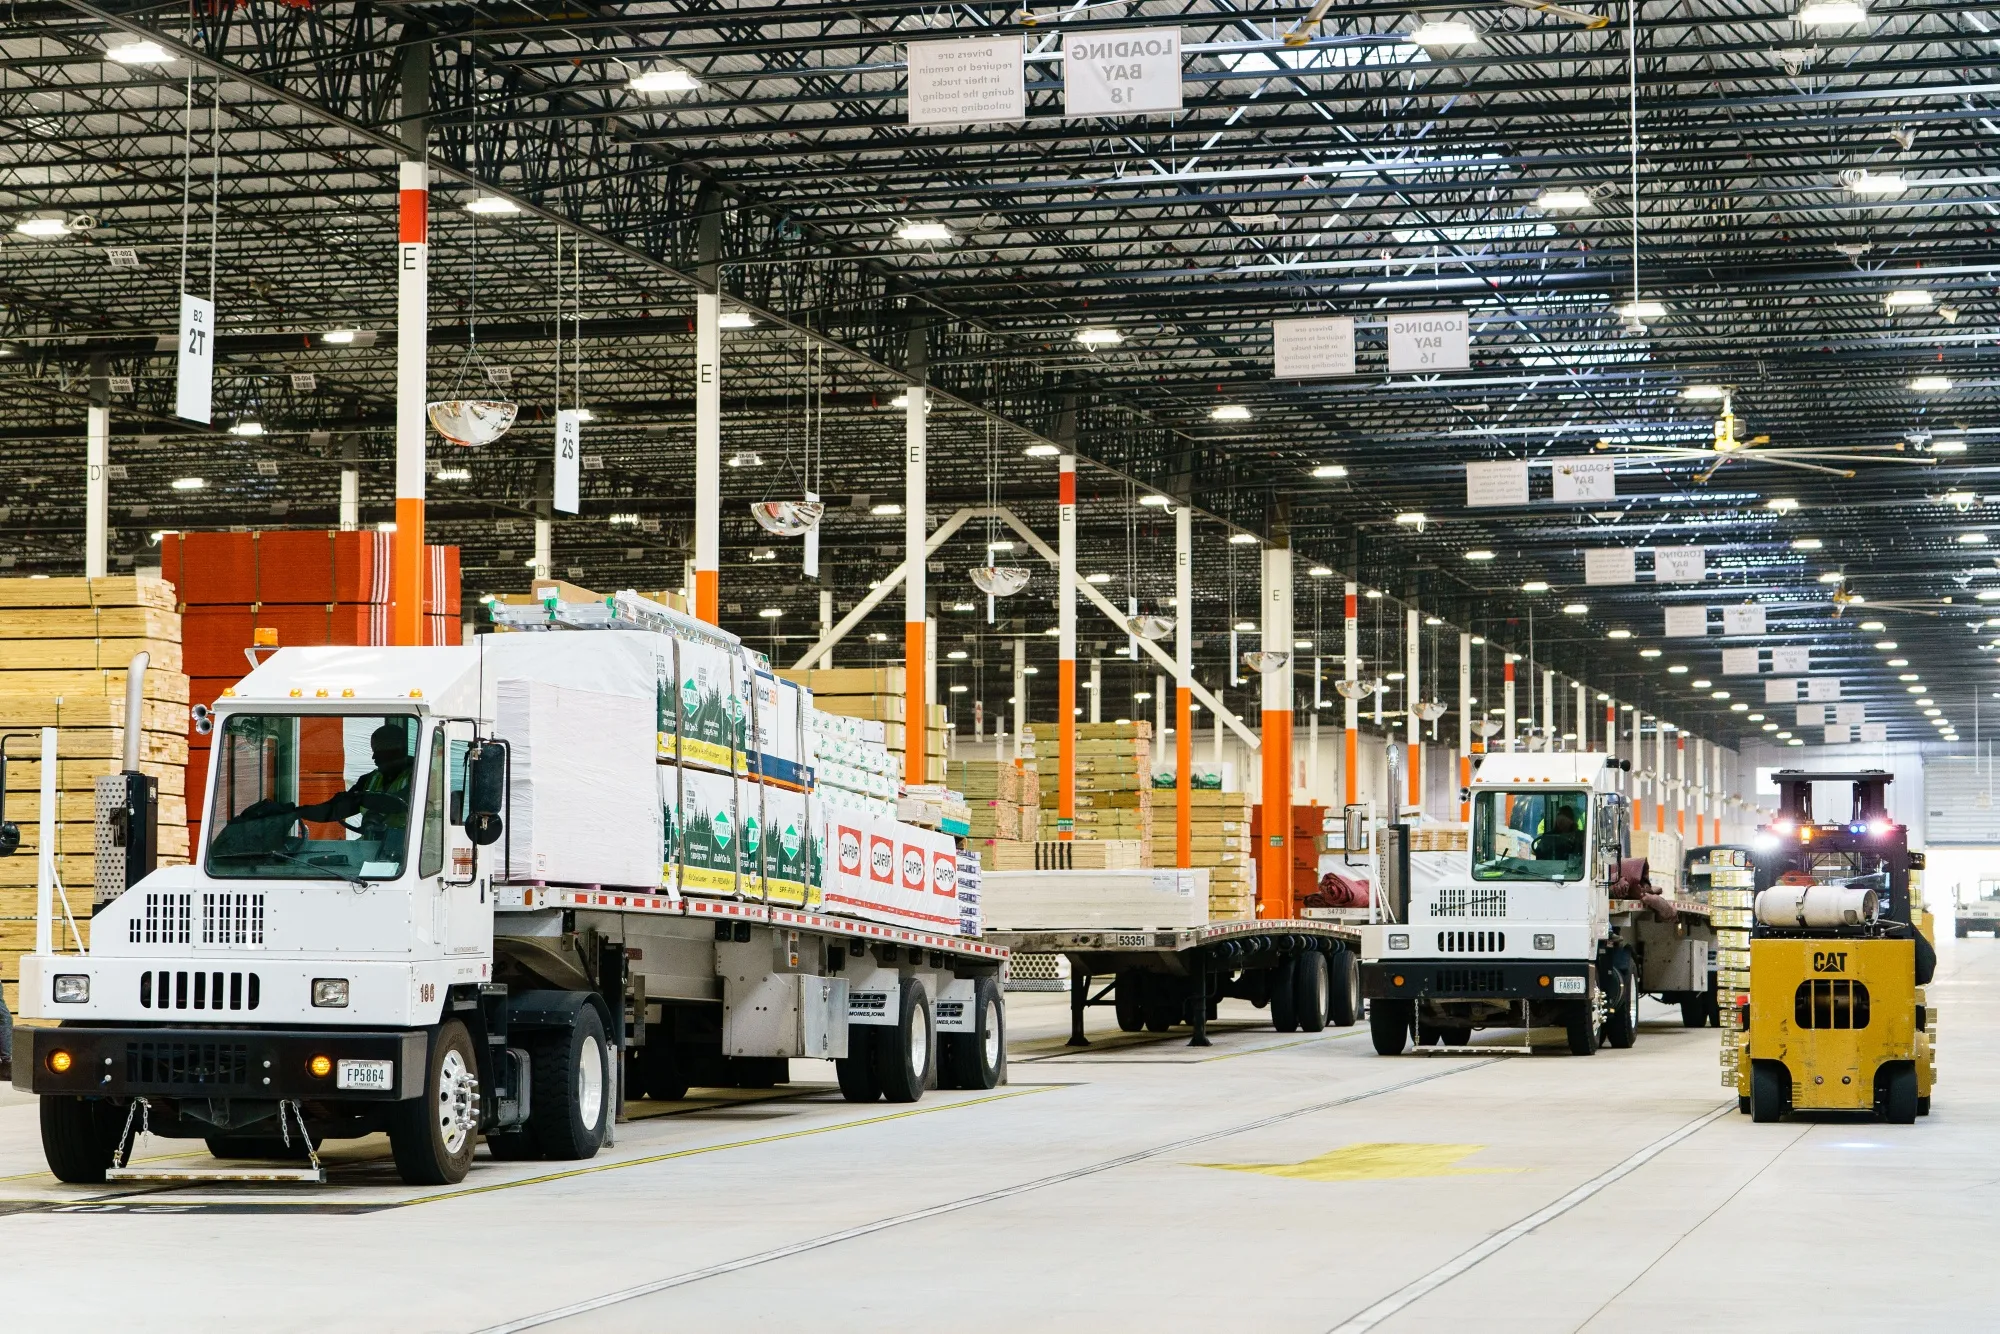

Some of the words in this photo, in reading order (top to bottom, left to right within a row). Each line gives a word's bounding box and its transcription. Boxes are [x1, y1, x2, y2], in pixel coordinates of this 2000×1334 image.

[404, 248, 416, 270] E
[194, 309, 203, 323] B2
[189, 328, 206, 356] 2T
[702, 364, 712, 383] E
[565, 422, 572, 433] B2
[562, 437, 573, 460] 2S
[911, 446, 919, 462] E
[91, 465, 101, 480] D
[1063, 507, 1070, 521] E
[1180, 553, 1186, 565] E
[1273, 590, 1280, 601] E
[1017, 670, 1022, 679] D
[1120, 936, 1145, 945] 53351
[1814, 952, 1847, 972] CAT
[347, 1069, 384, 1082] FP5864
